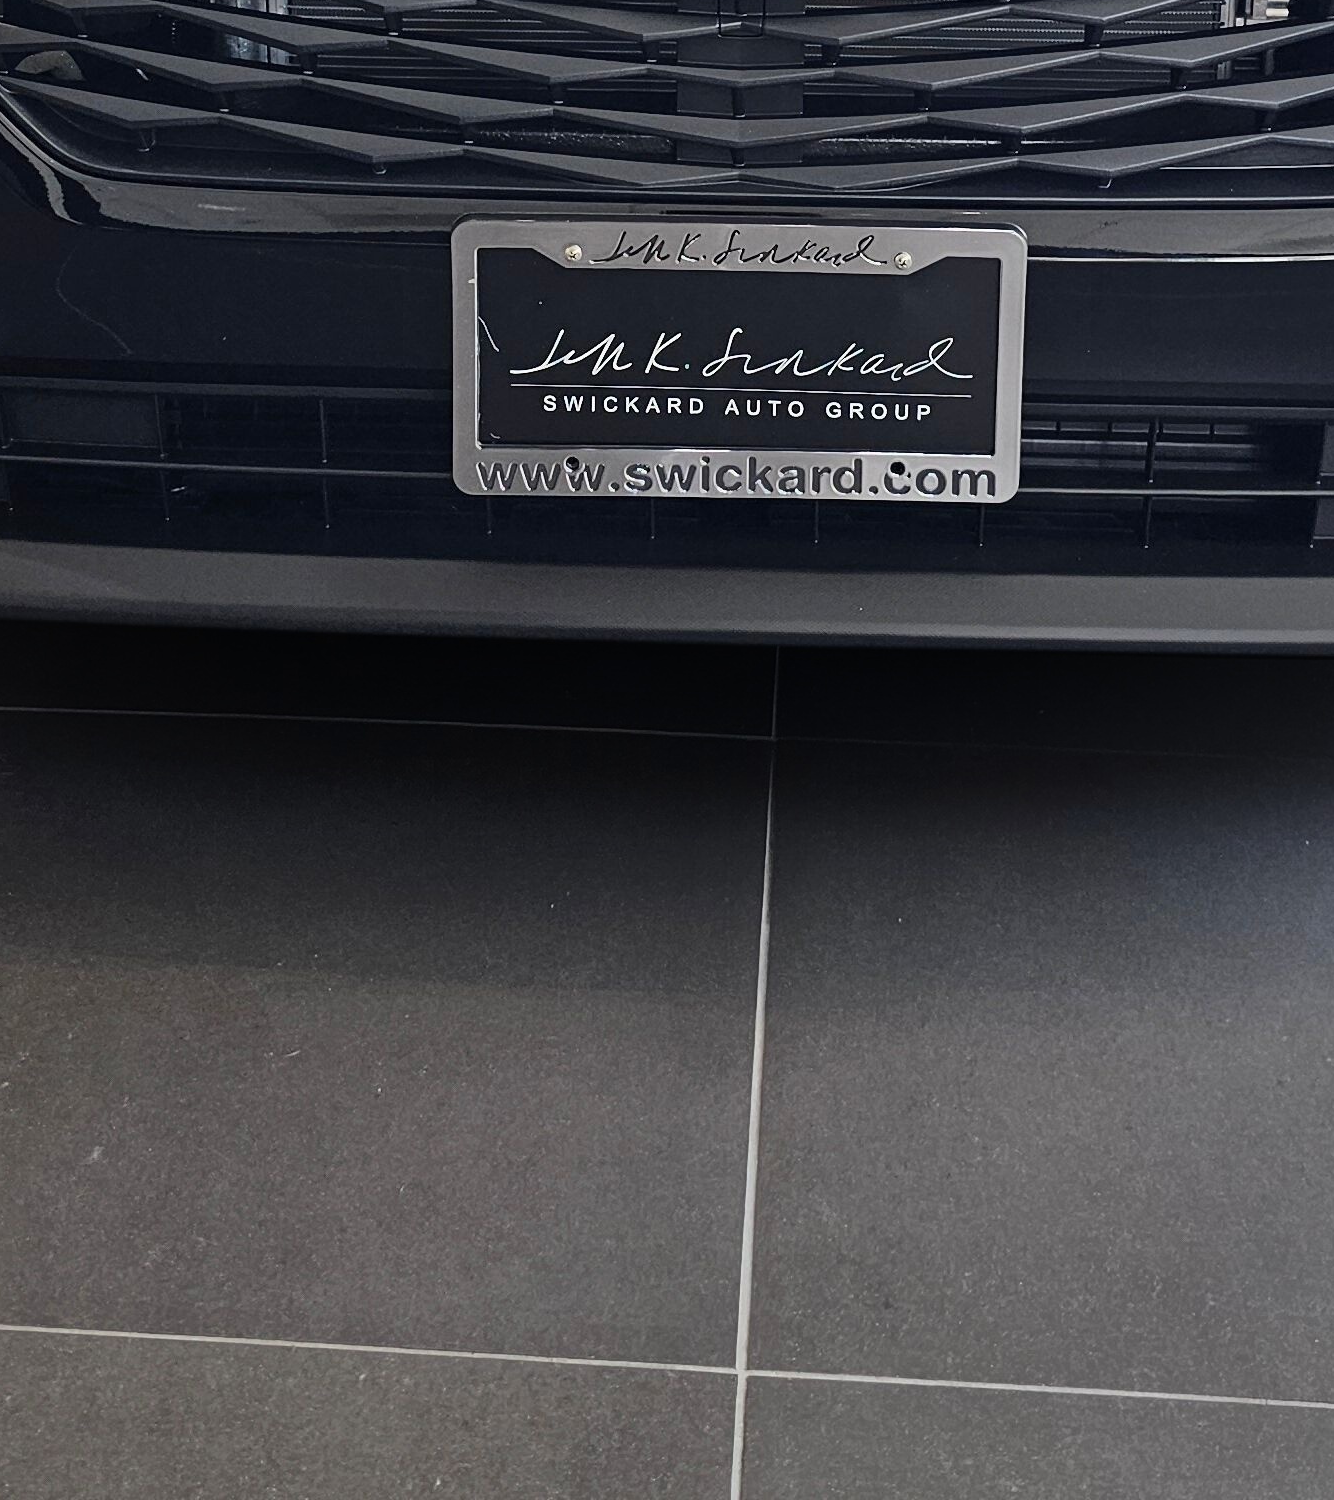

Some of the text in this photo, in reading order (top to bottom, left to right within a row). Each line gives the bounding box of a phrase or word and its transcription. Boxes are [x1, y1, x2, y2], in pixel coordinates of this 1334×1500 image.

[543, 394, 932, 421] SWICKARD AUTO GROUP
[476, 454, 996, 498] www.swickard.com
